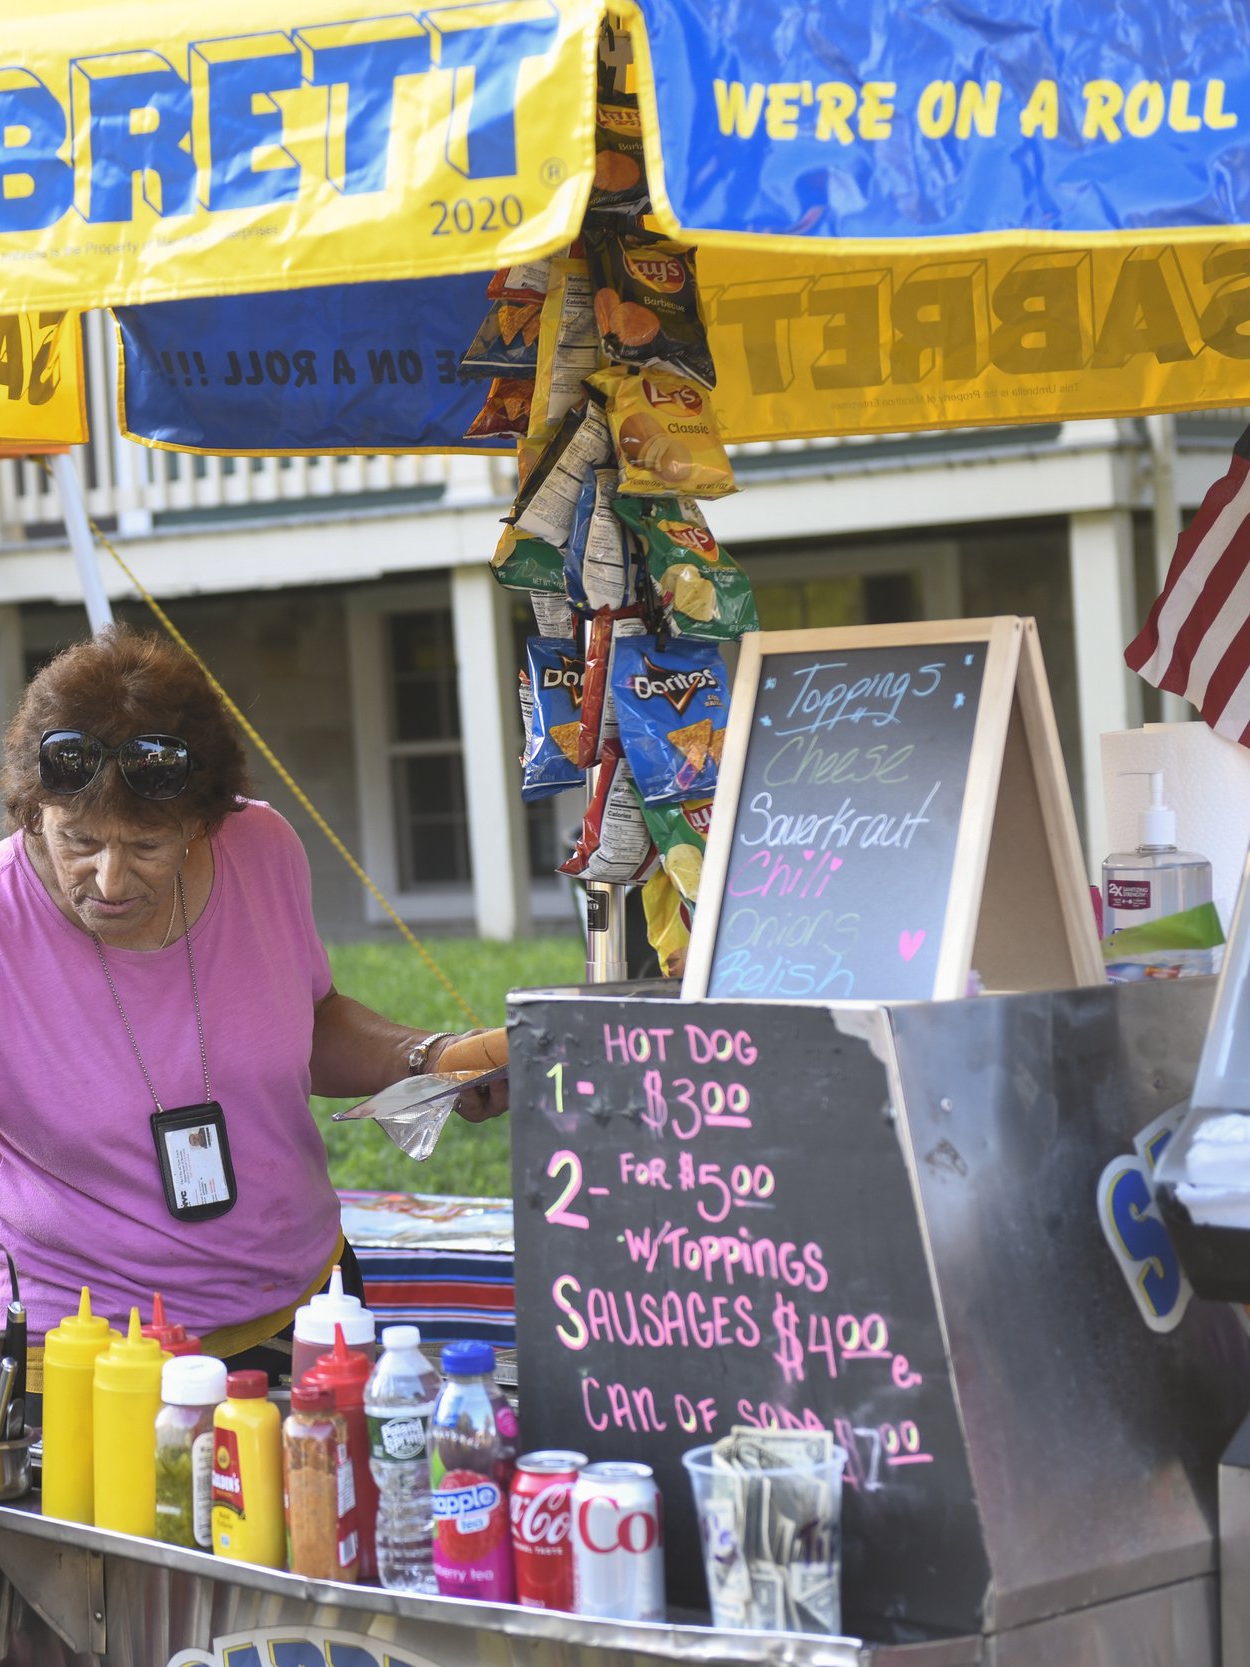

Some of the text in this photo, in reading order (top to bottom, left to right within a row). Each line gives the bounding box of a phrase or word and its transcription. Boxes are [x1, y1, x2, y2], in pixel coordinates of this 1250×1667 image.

[713, 79, 1238, 145] WE'RE ON A ROLL
[429, 193, 525, 237] 2020
[667, 423, 710, 434] Classic
[634, 667, 717, 700] Doritos
[787, 662, 946, 731] Toppings
[763, 735, 915, 788] Cheese
[740, 781, 941, 850] Sauerkraut
[727, 849, 843, 899] Chili
[1108, 883, 1123, 897] 2X
[724, 908, 860, 956] Onions
[716, 949, 855, 996] Relish
[604, 1024, 758, 1065] HOT DOG
[553, 1273, 761, 1350] SAUSAGES
[581, 1376, 667, 1432] CAN
[675, 1393, 718, 1434] OF
